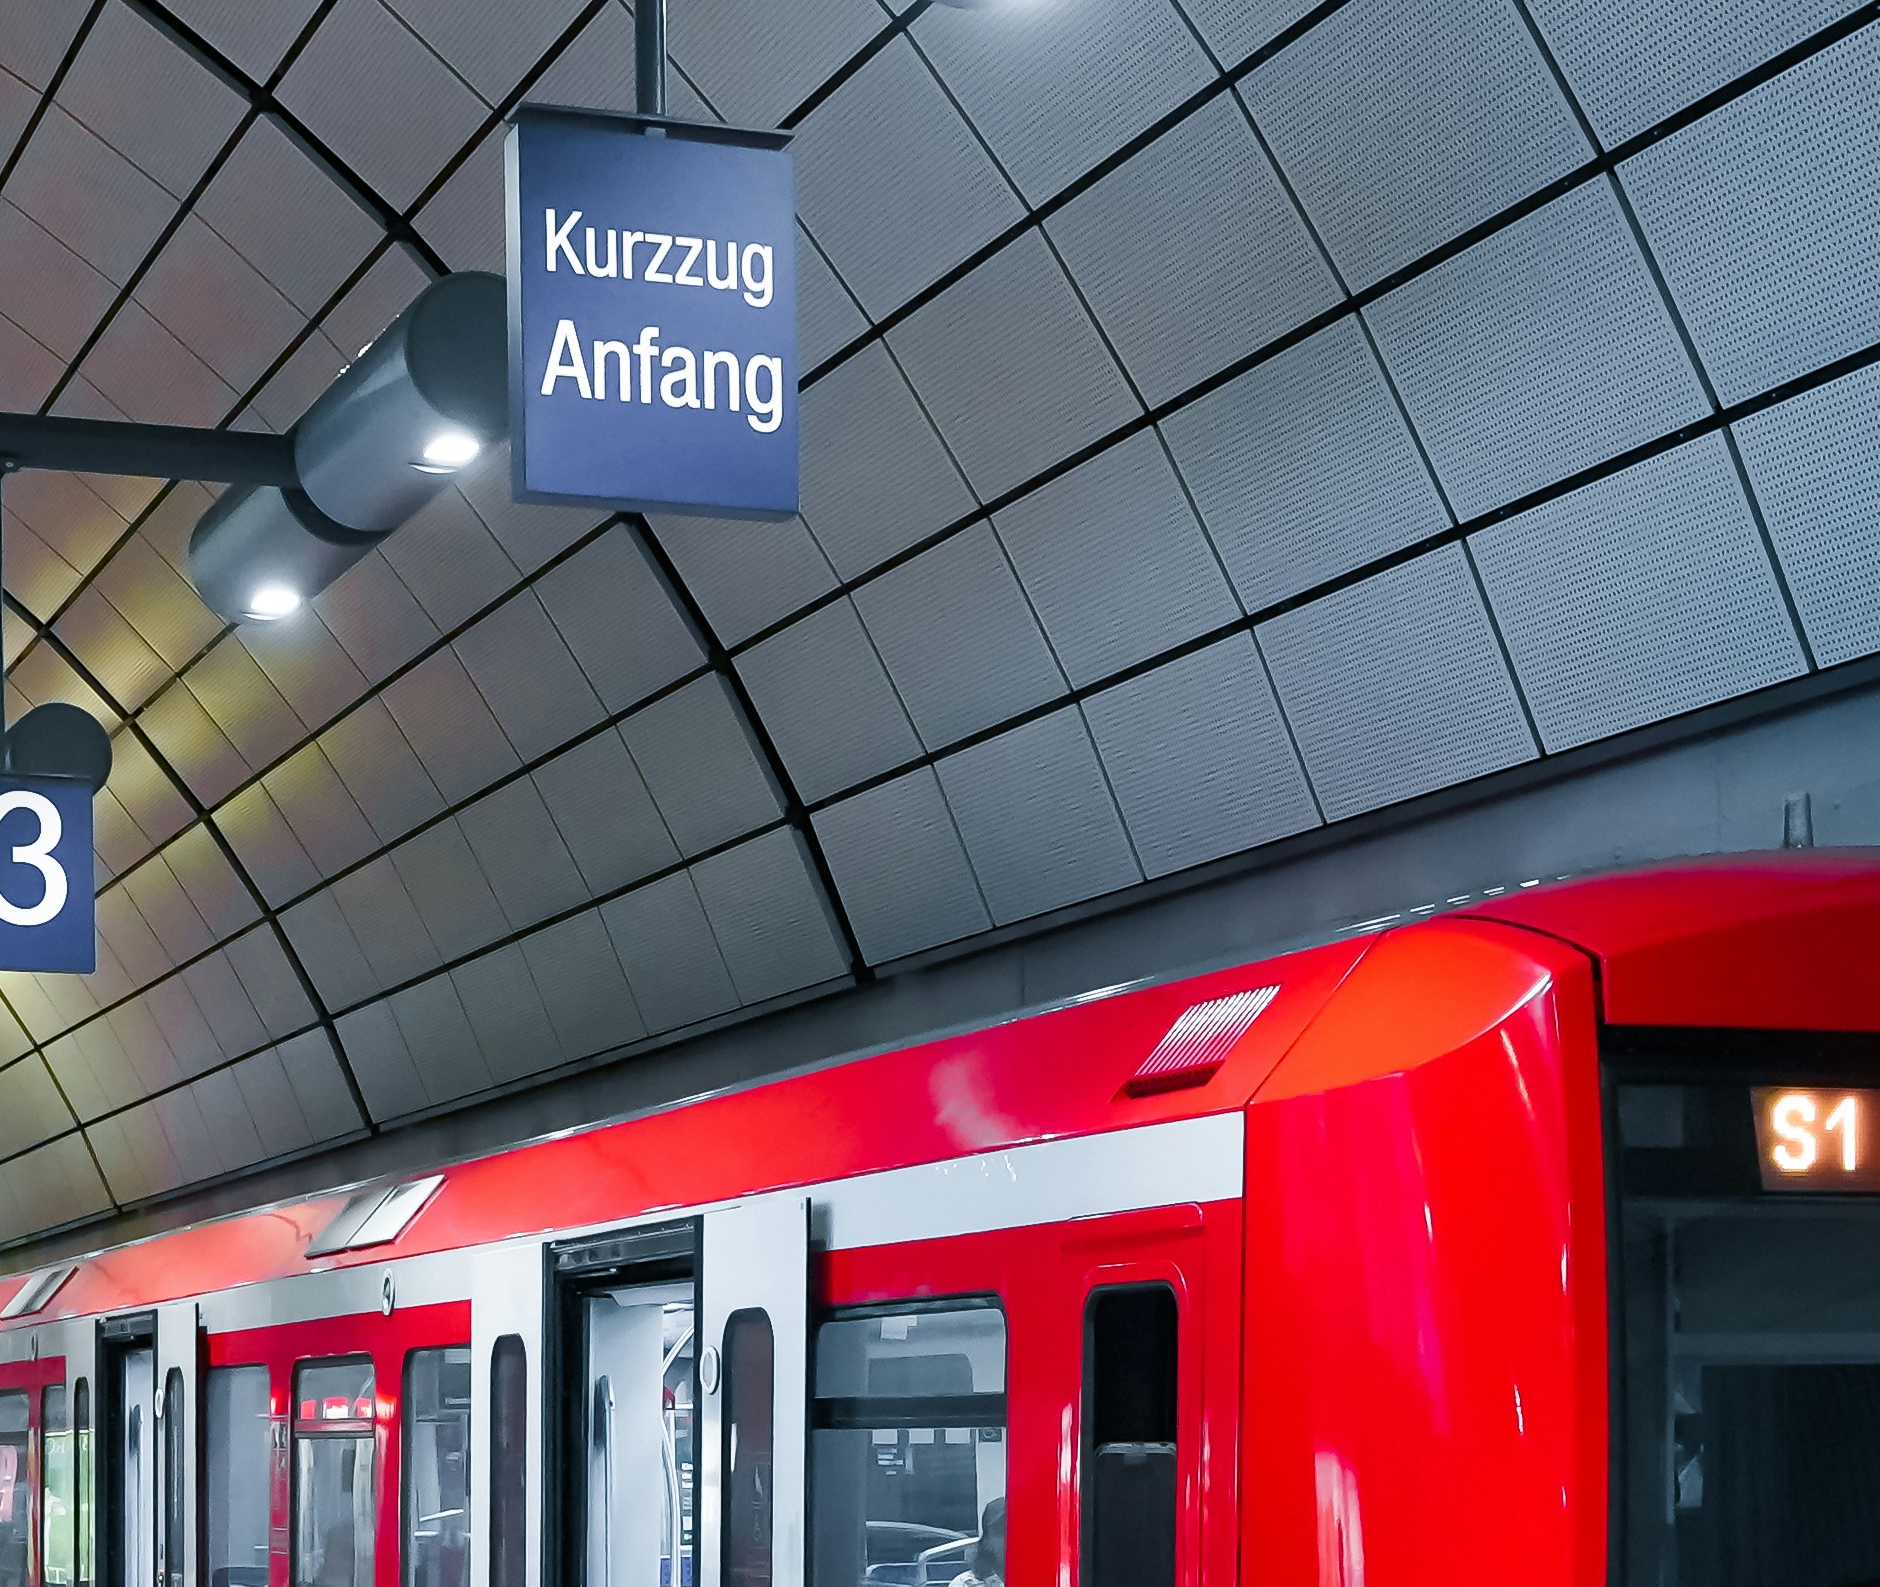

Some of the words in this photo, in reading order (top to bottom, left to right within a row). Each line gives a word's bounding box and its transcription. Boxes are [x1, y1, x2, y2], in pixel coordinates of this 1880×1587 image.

[544, 208, 775, 308] Kurzzug
[540, 319, 784, 434] Anfang
[1771, 1094, 1859, 1175] S1
